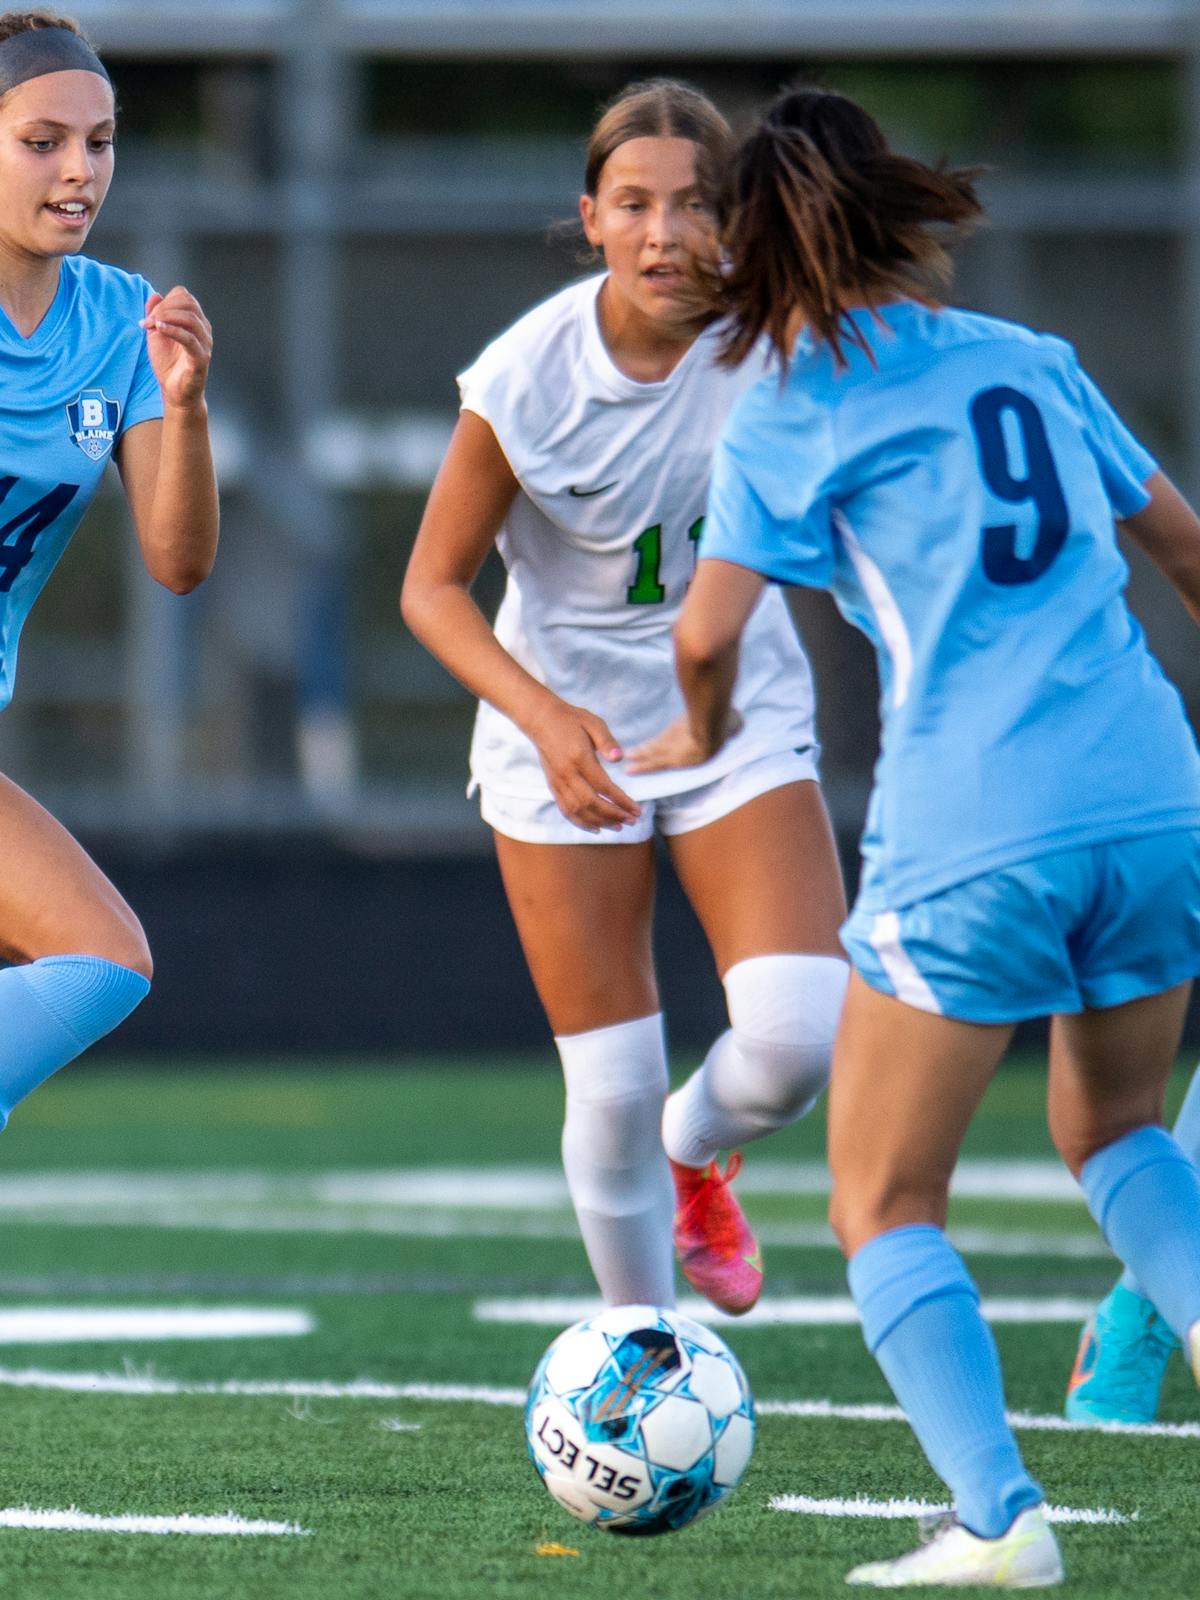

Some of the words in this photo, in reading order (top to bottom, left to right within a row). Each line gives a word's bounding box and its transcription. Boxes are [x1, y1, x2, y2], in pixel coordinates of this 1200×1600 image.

[75, 429, 115, 442] BLAINE
[82, 399, 104, 427] B
[968, 386, 1070, 585] 9
[626, 515, 707, 605] 1
[538, 1416, 643, 1500] SELECT
